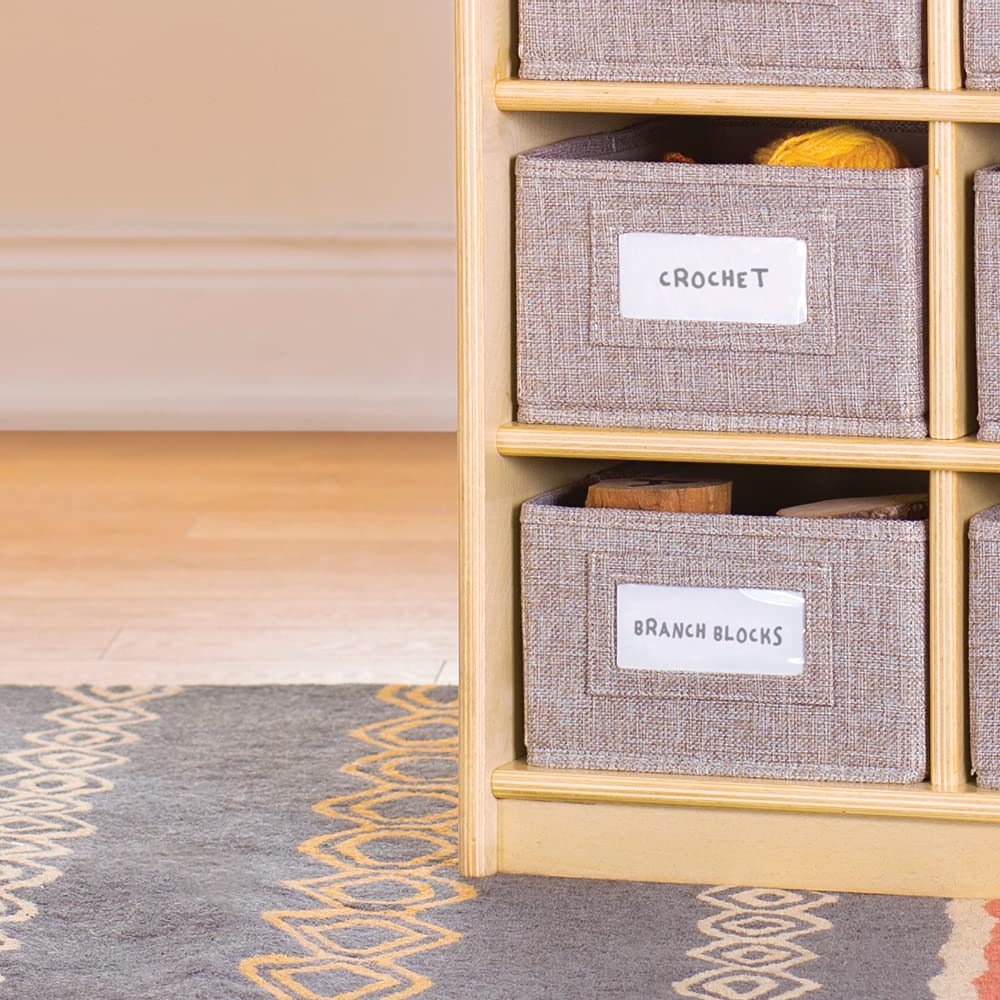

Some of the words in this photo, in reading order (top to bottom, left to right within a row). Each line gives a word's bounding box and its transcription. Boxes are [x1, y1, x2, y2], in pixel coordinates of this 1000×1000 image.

[659, 268, 769, 289] CROCHET
[634, 617, 706, 639] BRANCH
[713, 625, 783, 646] BLOCKS
